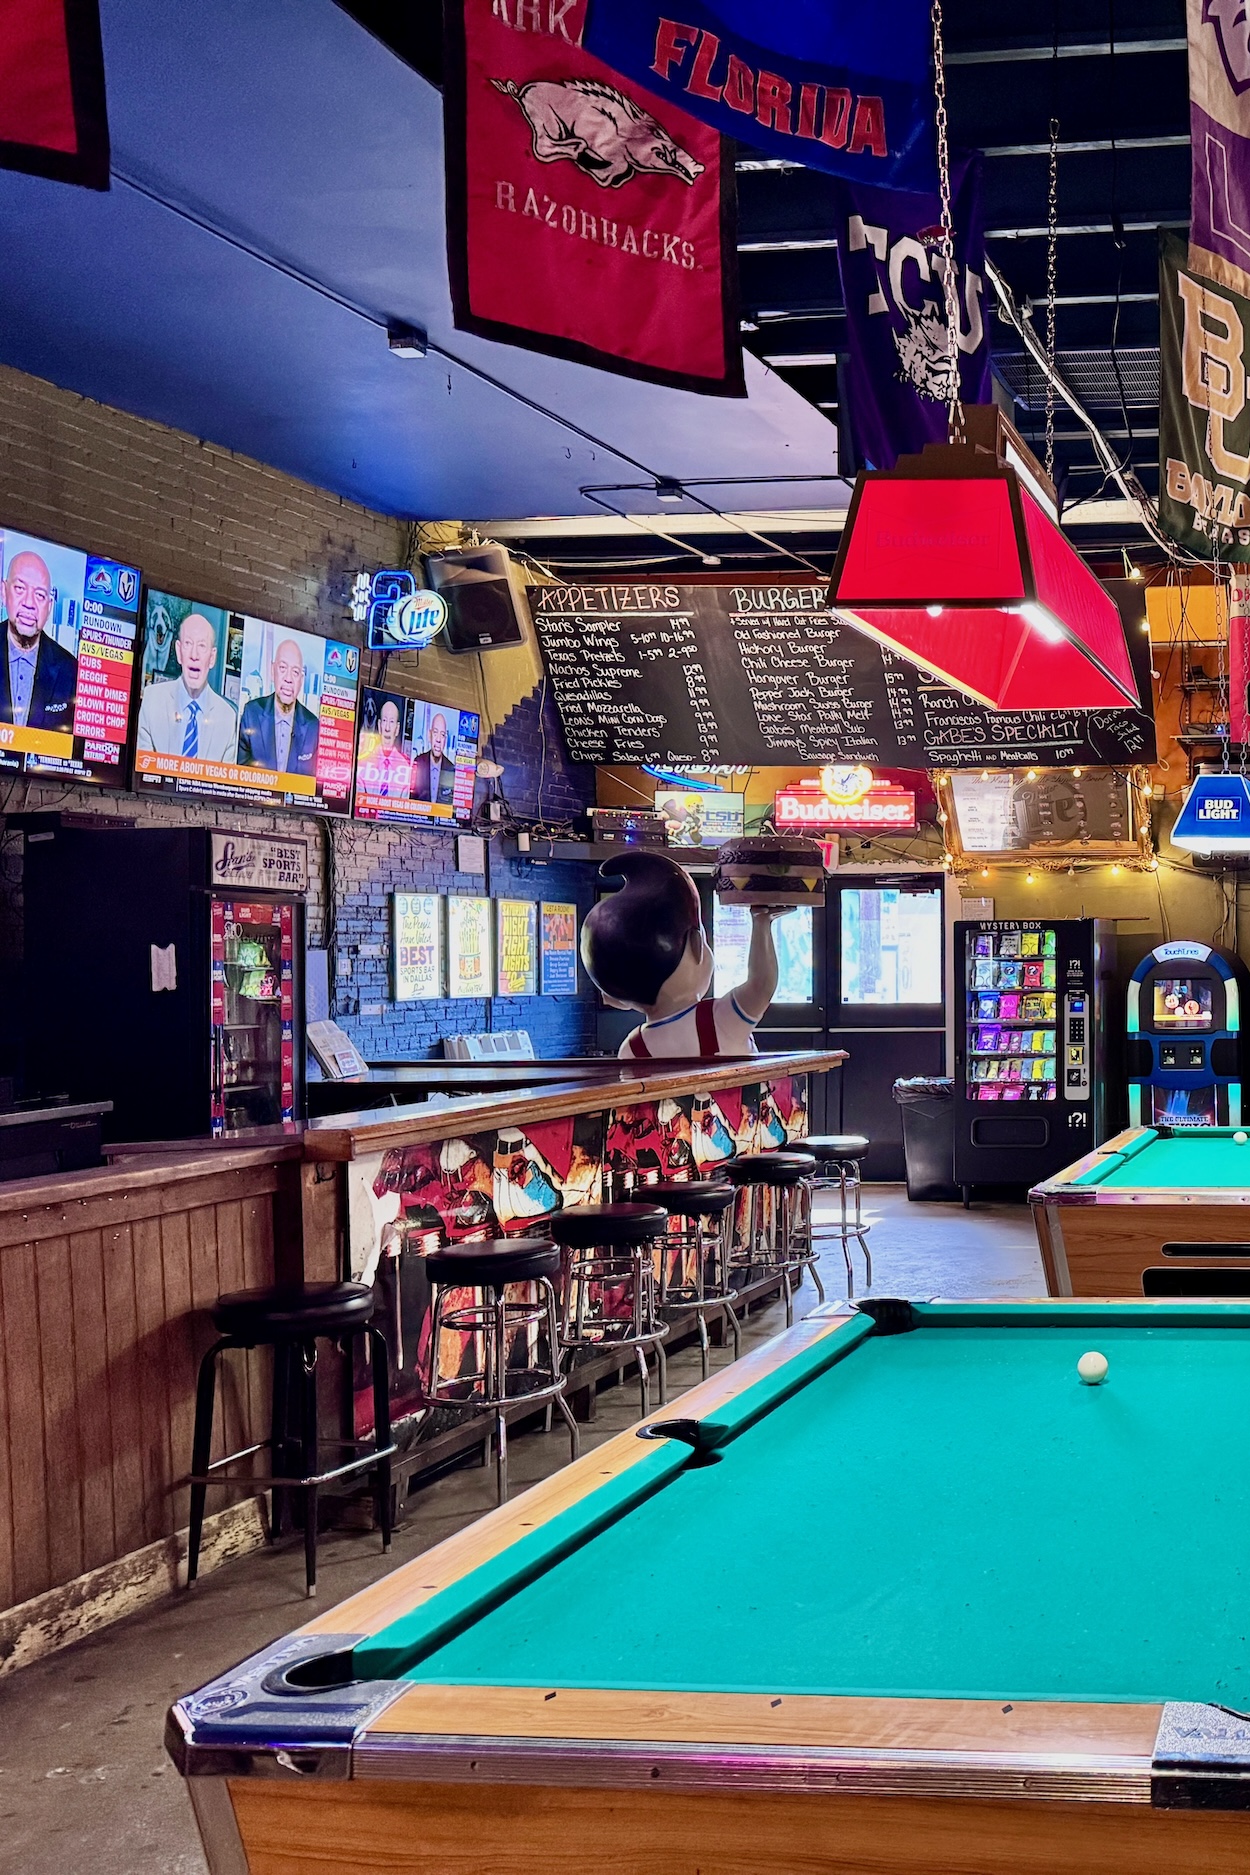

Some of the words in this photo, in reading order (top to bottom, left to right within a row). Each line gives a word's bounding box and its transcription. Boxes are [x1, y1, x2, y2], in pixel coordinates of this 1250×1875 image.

[649, 17, 888, 157] FLORIDA
[494, 181, 696, 270] RAZORBACKS
[849, 216, 982, 355] TCU
[538, 587, 679, 611] APPETIZERS
[729, 587, 829, 612] BURGER
[84, 601, 104, 615] 0:00
[84, 616, 122, 634] RUNDOWN
[408, 609, 439, 635] Lite
[575, 617, 621, 635] Sampler
[82, 629, 132, 650] SPURS/THUNDER
[541, 635, 581, 648] Jumbo
[583, 634, 619, 652] Wings
[734, 630, 750, 640] Old
[752, 629, 800, 640] Fashioned
[804, 628, 841, 644] Burger
[81, 643, 124, 661] AVS/VEGAS
[545, 650, 577, 662] Texas
[580, 648, 625, 662] Pretzels
[738, 642, 784, 657] Hickory
[787, 642, 827, 654] Burger
[80, 656, 102, 669] CUBS
[741, 657, 767, 669] Chili
[770, 657, 811, 668] Cheese
[813, 653, 855, 674] Burger
[79, 670, 108, 685] REGGIE
[549, 663, 590, 676] Nachos
[592, 664, 643, 680] Supreme
[552, 678, 580, 690] Fried
[581, 678, 622, 689] Pickles
[746, 670, 799, 690] Hangover
[805, 671, 850, 689] Burger
[78, 683, 102, 697] DANNY
[104, 689, 128, 701] DIMES
[323, 686, 349, 697] RUNDOWN
[554, 691, 612, 701] Quesadillas
[749, 687, 783, 700] Pepper
[787, 687, 815, 698] Jack
[818, 686, 854, 700] Burger
[77, 697, 104, 710] BLOWN
[106, 704, 125, 715] FOUL
[558, 702, 582, 713] Fried
[587, 703, 645, 714] Mozzarella
[753, 701, 806, 711] Mushroom
[809, 699, 841, 710] Swiss
[842, 698, 874, 709] Burger
[919, 694, 959, 709] Ranch
[76, 711, 105, 724] CROTCH
[106, 717, 125, 728] CHOP
[321, 707, 350, 719] AVS/VEGAS
[756, 712, 785, 722] Lone
[788, 712, 812, 721] Star
[846, 710, 872, 720] Melt
[983, 713, 1021, 724] Famous
[1022, 711, 1045, 722] Chili
[321, 718, 335, 727] CUBS
[645, 714, 667, 728] Dogs
[800, 723, 842, 734] Meatball
[844, 721, 865, 733] Sub
[1106, 720, 1128, 733] Taco
[75, 724, 106, 738] ERRORS
[320, 728, 339, 737] REGGIE
[565, 727, 608, 738] Chicken
[614, 726, 660, 738] Tenders
[924, 727, 986, 745] GABE'S
[992, 720, 1078, 741] SPECIALTY
[567, 738, 606, 748] Cheese
[614, 739, 644, 749] Fries
[809, 737, 839, 752] Spicy
[841, 735, 878, 747] Italian
[800, 749, 837, 763] Sausage
[839, 751, 880, 761] Sandwich
[928, 751, 982, 766] Spaghetti
[1000, 750, 1039, 761] Meatballs
[156, 759, 179, 772] MORE
[182, 763, 204, 775] ABOUT
[205, 766, 227, 779] VEGAS
[228, 769, 239, 780] OR
[240, 771, 279, 786] COLORADO?
[1204, 799, 1234, 810] BUD
[705, 811, 739, 821] LSU
[1199, 809, 1238, 820] LIGHT
[262, 858, 301, 872] SPORTS
[402, 916, 412, 929] The
[413, 916, 431, 931] People
[503, 916, 529, 936] NIGHT
[503, 936, 529, 955] FIGHT
[400, 946, 434, 966] BEST
[400, 967, 422, 975] SPORTS
[410, 974, 432, 982] DALLAS
